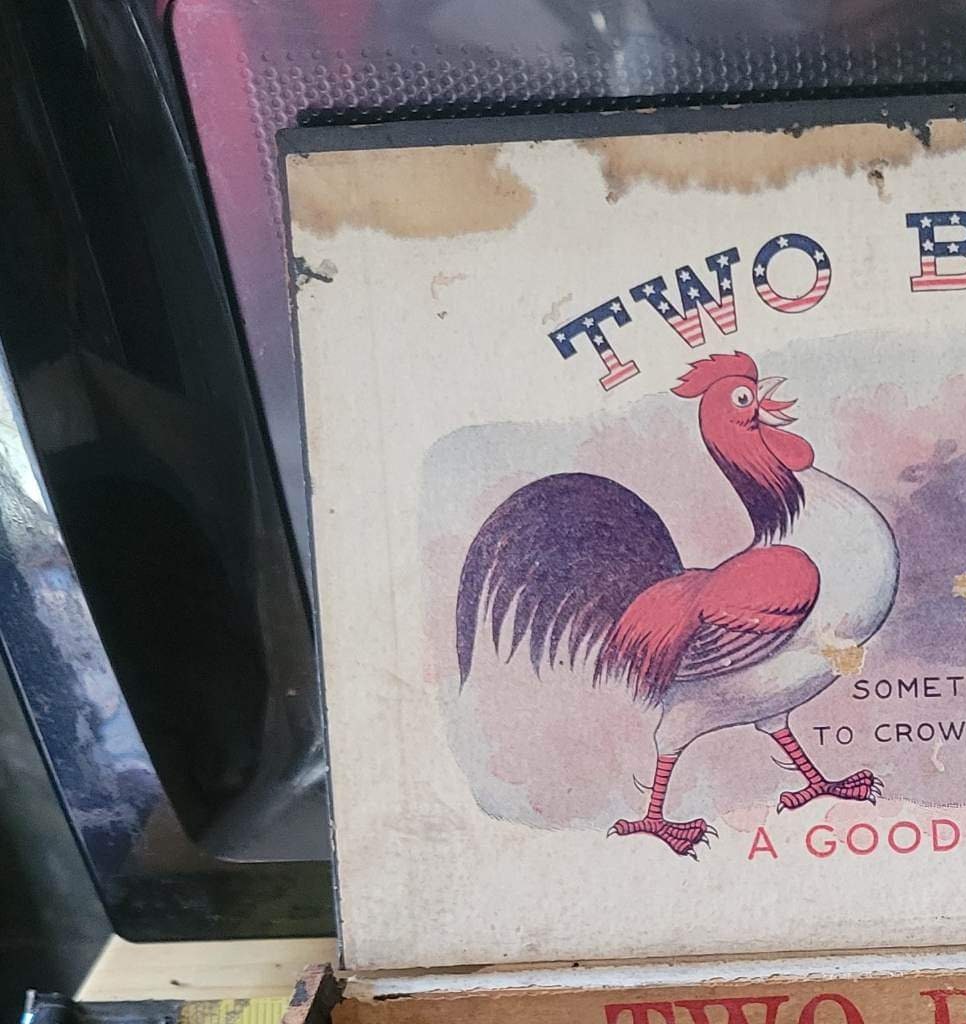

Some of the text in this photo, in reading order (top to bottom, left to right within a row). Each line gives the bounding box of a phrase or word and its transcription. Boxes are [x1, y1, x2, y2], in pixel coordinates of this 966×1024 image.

[547, 233, 832, 392] TWO
[813, 726, 854, 746] TO
[874, 721, 966, 743] CROW
[748, 826, 779, 861] A
[805, 819, 961, 859] GOOD
